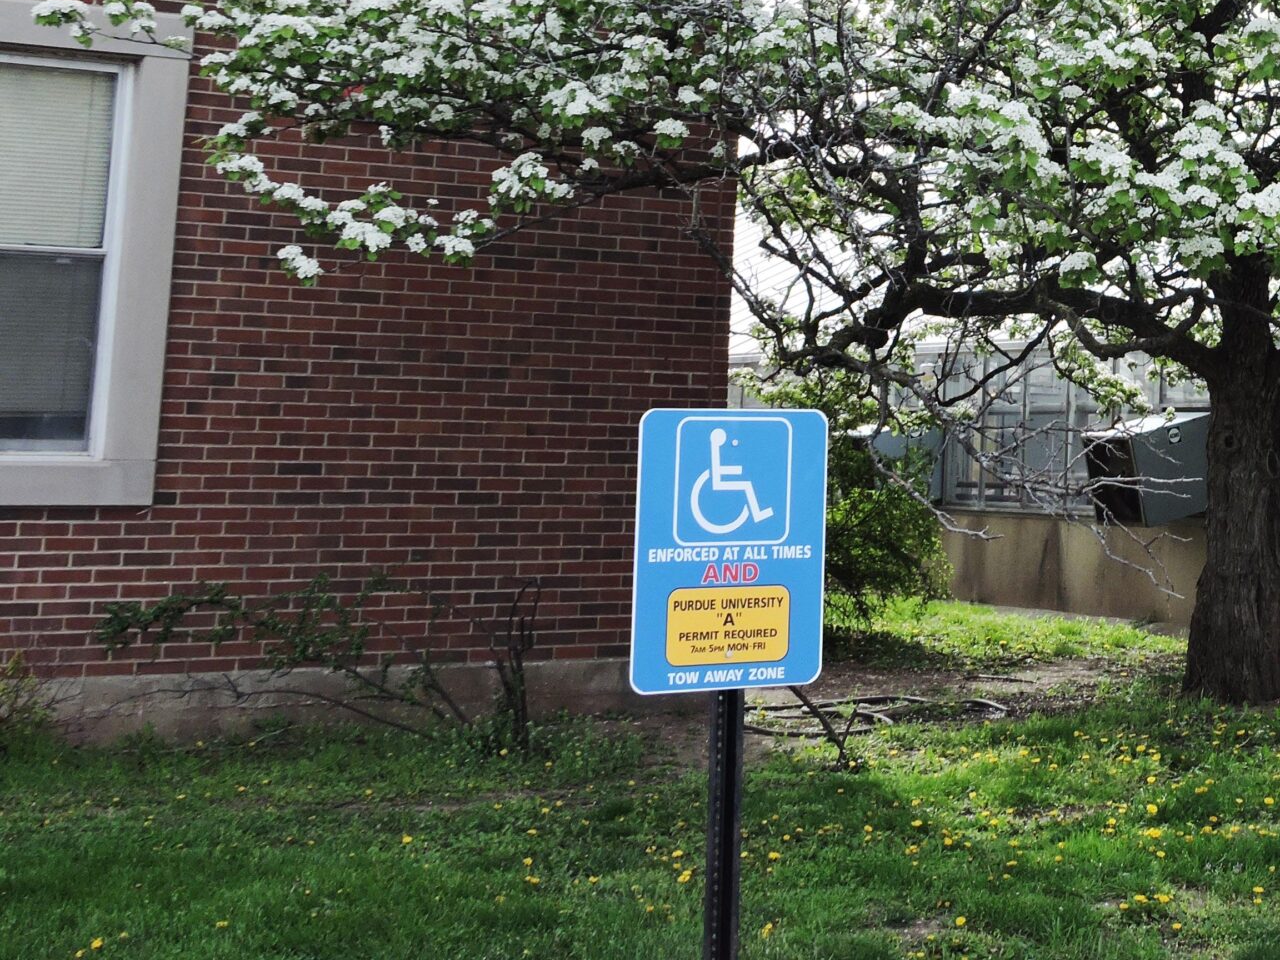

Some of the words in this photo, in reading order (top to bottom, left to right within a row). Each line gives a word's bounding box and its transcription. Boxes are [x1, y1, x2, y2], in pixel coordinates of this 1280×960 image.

[648, 546, 718, 562] ENFORCED
[723, 546, 740, 560] AT
[743, 546, 768, 560] ALL
[772, 545, 812, 559] TIMES
[701, 562, 759, 584] AND
[673, 599, 716, 611] PURDUE
[721, 597, 784, 610] UNIVERSITY
[679, 630, 719, 642] PERMIT
[724, 628, 778, 640] REQUIRED
[667, 671, 700, 685] TOW
[704, 669, 744, 683] AWAY
[748, 667, 785, 680] ZONE
